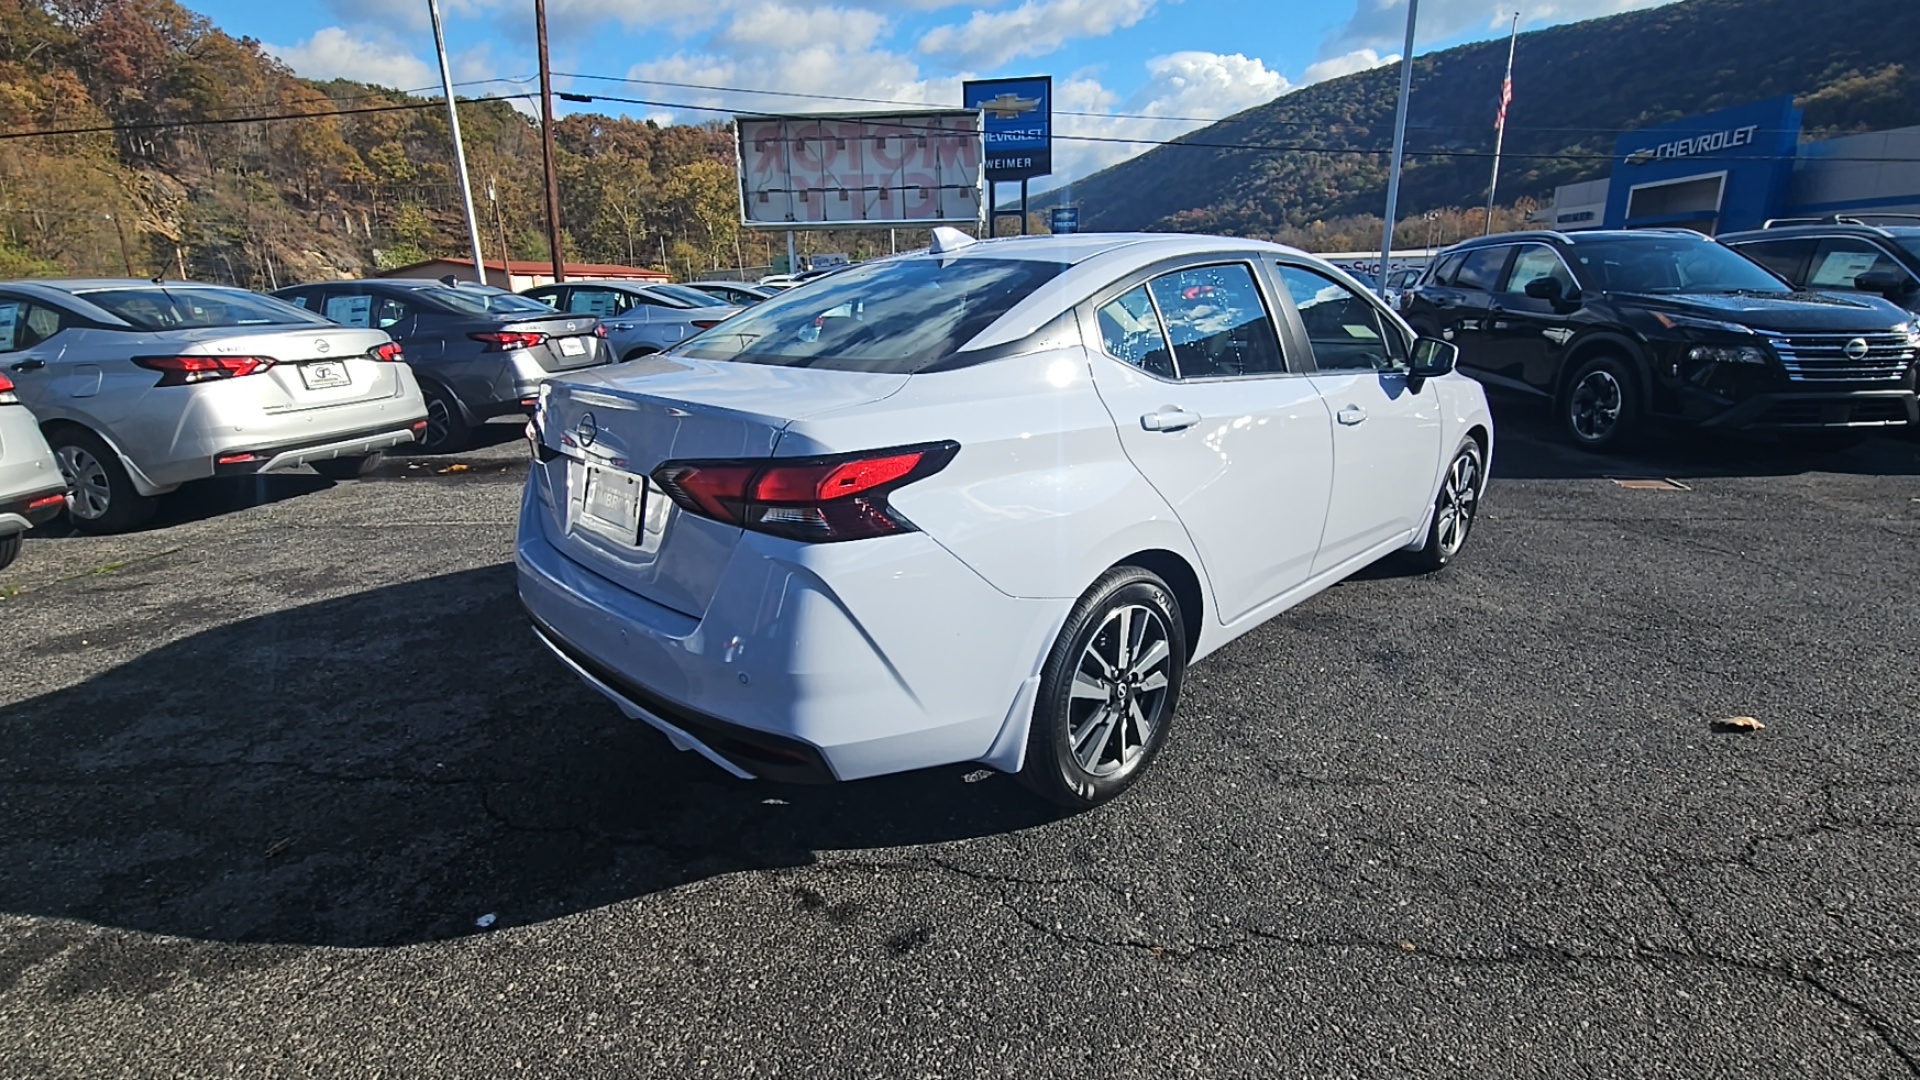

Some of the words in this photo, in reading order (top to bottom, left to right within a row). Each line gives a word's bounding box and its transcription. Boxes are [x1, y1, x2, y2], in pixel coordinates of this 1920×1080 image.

[984, 129, 1043, 142] HEVROLET
[1655, 125, 1758, 159] CHEVROLET
[985, 157, 1032, 169] WEIMER
[1353, 261, 1400, 274] SHOS
